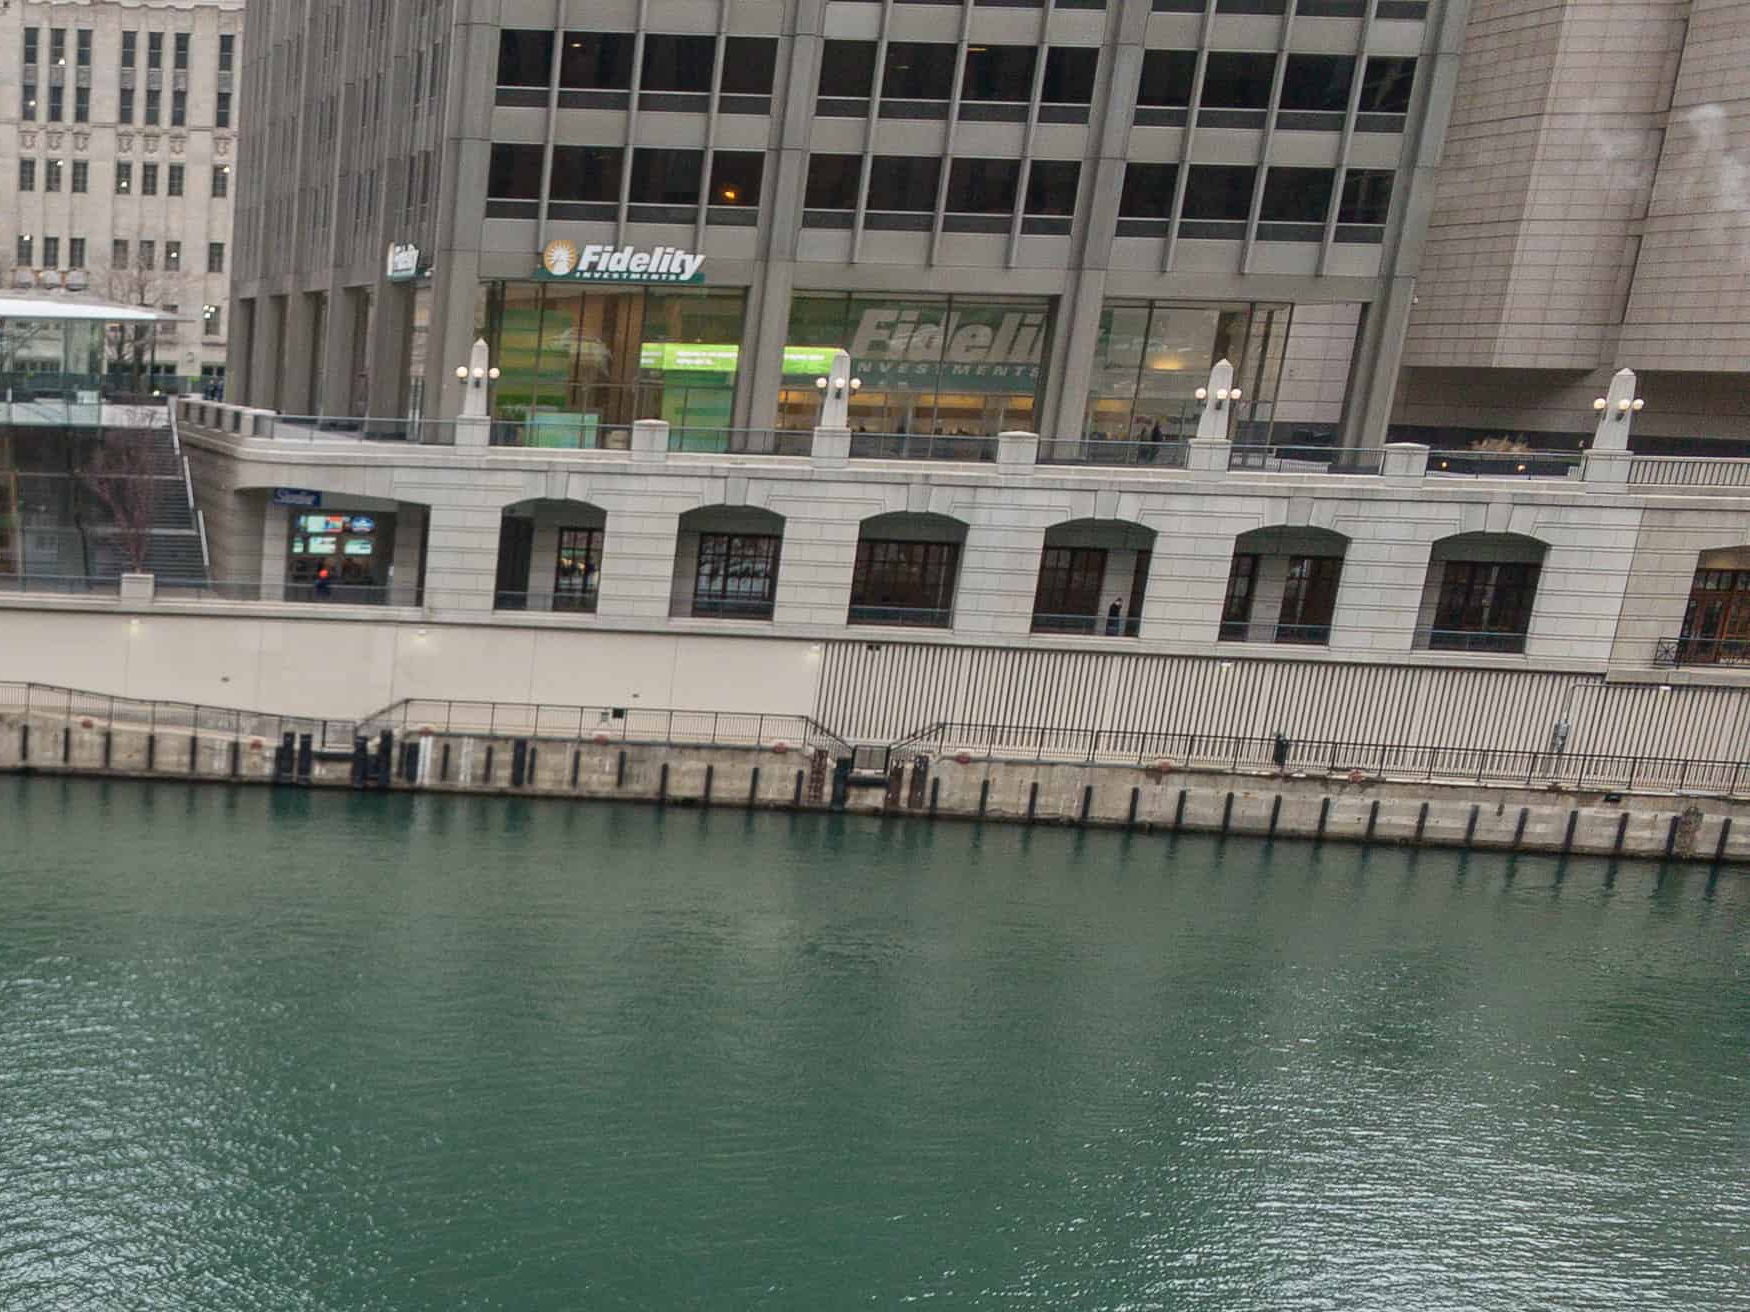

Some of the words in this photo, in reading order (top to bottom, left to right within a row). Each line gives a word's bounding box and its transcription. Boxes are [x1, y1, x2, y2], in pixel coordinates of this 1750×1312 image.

[575, 271, 677, 281] INVESTMENTS
[577, 245, 705, 281] Fidelity
[850, 308, 1048, 362] Fideli
[857, 362, 1042, 378] NVESMENTS
